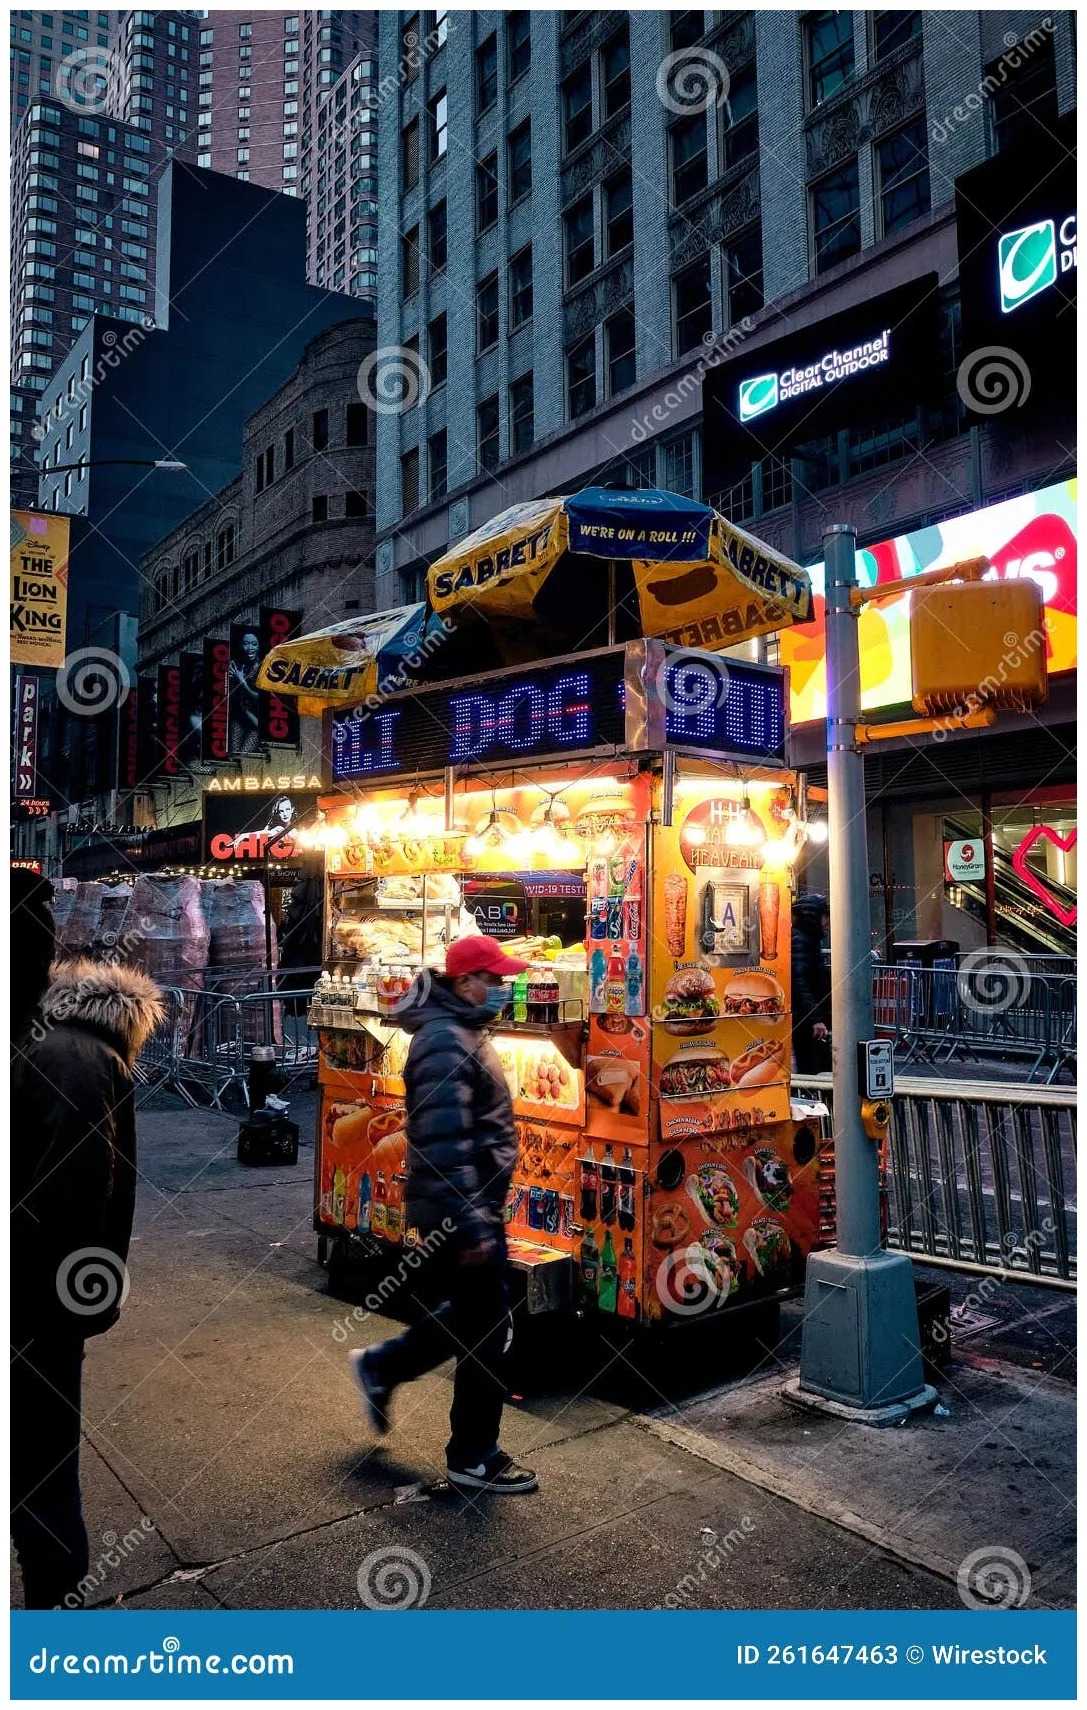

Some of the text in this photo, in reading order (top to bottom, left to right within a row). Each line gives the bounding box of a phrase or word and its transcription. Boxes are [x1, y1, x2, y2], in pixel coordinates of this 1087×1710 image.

[780, 349, 889, 400] DIGITAL OUTDOOR
[580, 524, 615, 539] WE'RE
[617, 529, 635, 541] ON
[637, 530, 646, 541] A
[649, 530, 678, 543] ROLL
[21, 555, 53, 573] THE
[13, 576, 57, 602] LION
[10, 603, 62, 632] KING
[21, 683, 36, 767] park
[208, 776, 322, 791] AMBASSA
[31, 799, 50, 807] hours
[722, 902, 736, 927] A
